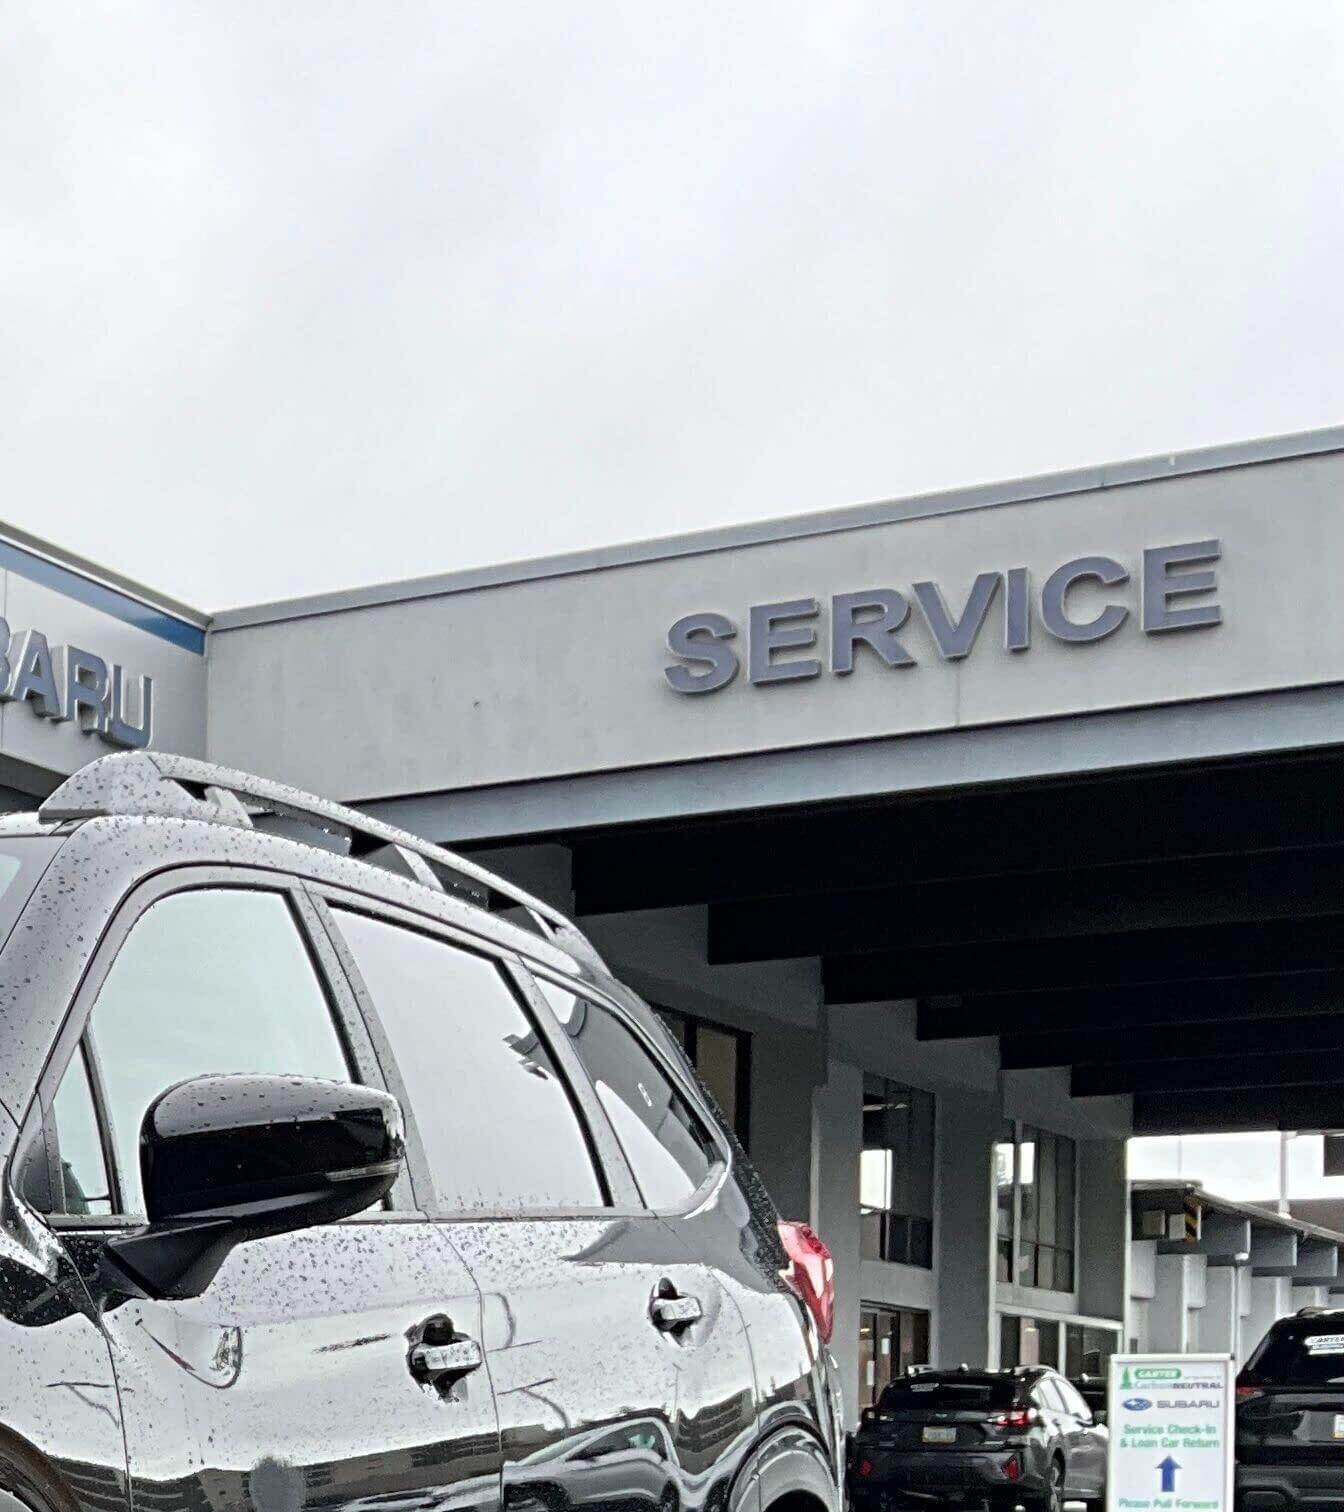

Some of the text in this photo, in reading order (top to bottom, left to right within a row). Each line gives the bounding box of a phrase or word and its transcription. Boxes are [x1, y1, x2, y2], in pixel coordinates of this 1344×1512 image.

[664, 538, 1223, 694] SERVICE
[1157, 1400, 1220, 1408] SUBARU
[1124, 1424, 1164, 1434] Service
[1119, 1438, 1220, 1448] & Loan Car Return
